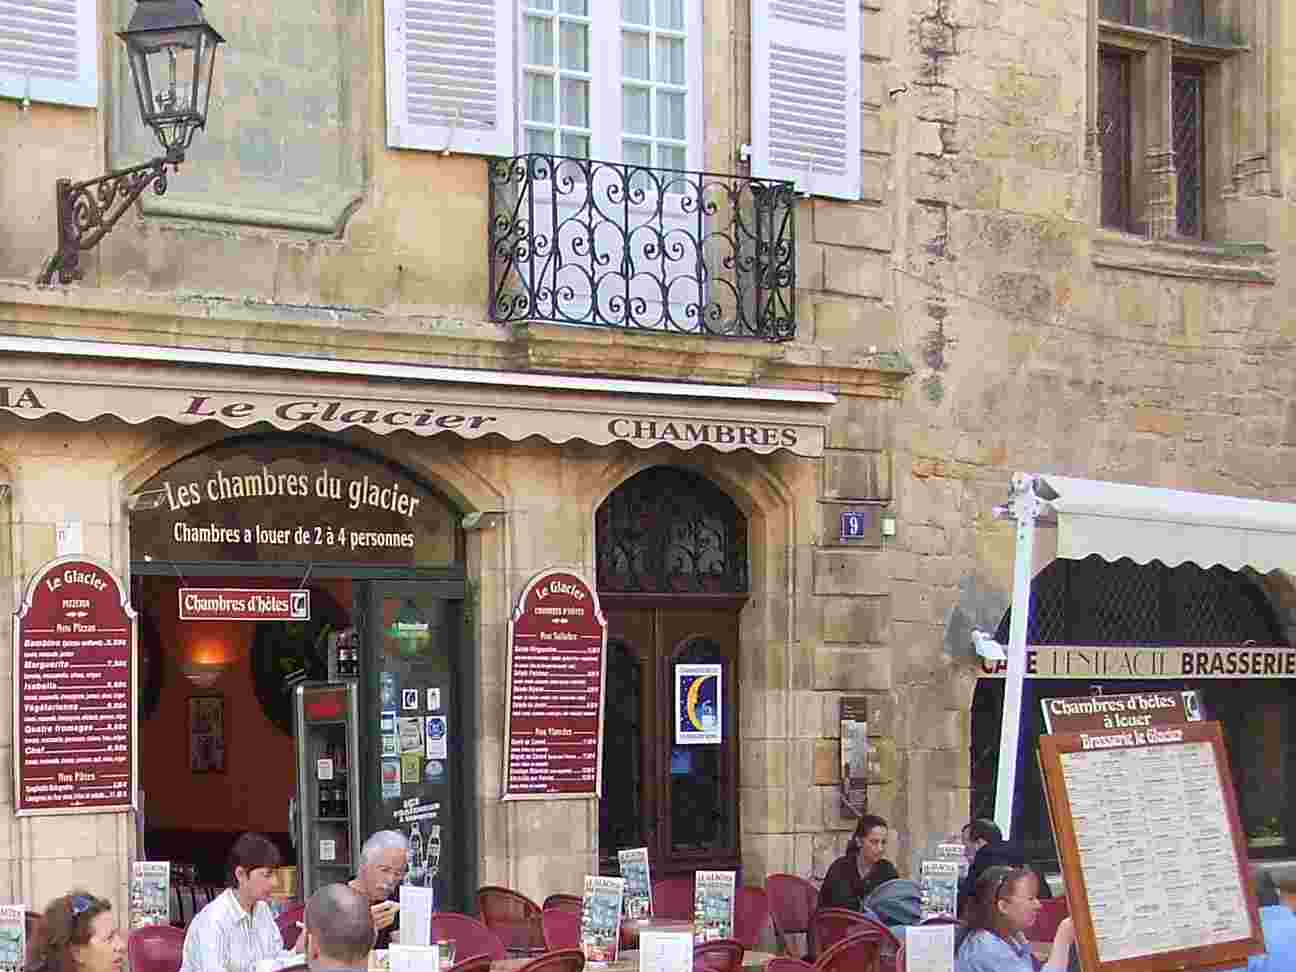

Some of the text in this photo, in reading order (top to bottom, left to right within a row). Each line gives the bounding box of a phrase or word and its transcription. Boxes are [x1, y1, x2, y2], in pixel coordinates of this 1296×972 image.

[184, 394, 498, 431] Le Glacier
[607, 417, 799, 448] CHAMBRES
[165, 466, 420, 518] Les chambres du glacier
[174, 522, 240, 544] Chambres
[256, 525, 291, 545] louer
[294, 526, 311, 545] de
[314, 526, 323, 545] 2
[338, 527, 346, 545] 4
[350, 529, 415, 550] personnes
[849, 515, 858, 535] 9
[46, 569, 108, 592] Le Glacier
[550, 580, 585, 600] Glacier
[184, 594, 245, 613] Chambres
[981, 651, 1038, 675] CAE
[1181, 651, 1296, 675] BRASSERIE
[1050, 697, 1125, 715] Chambres
[1103, 713, 1152, 728] à louer
